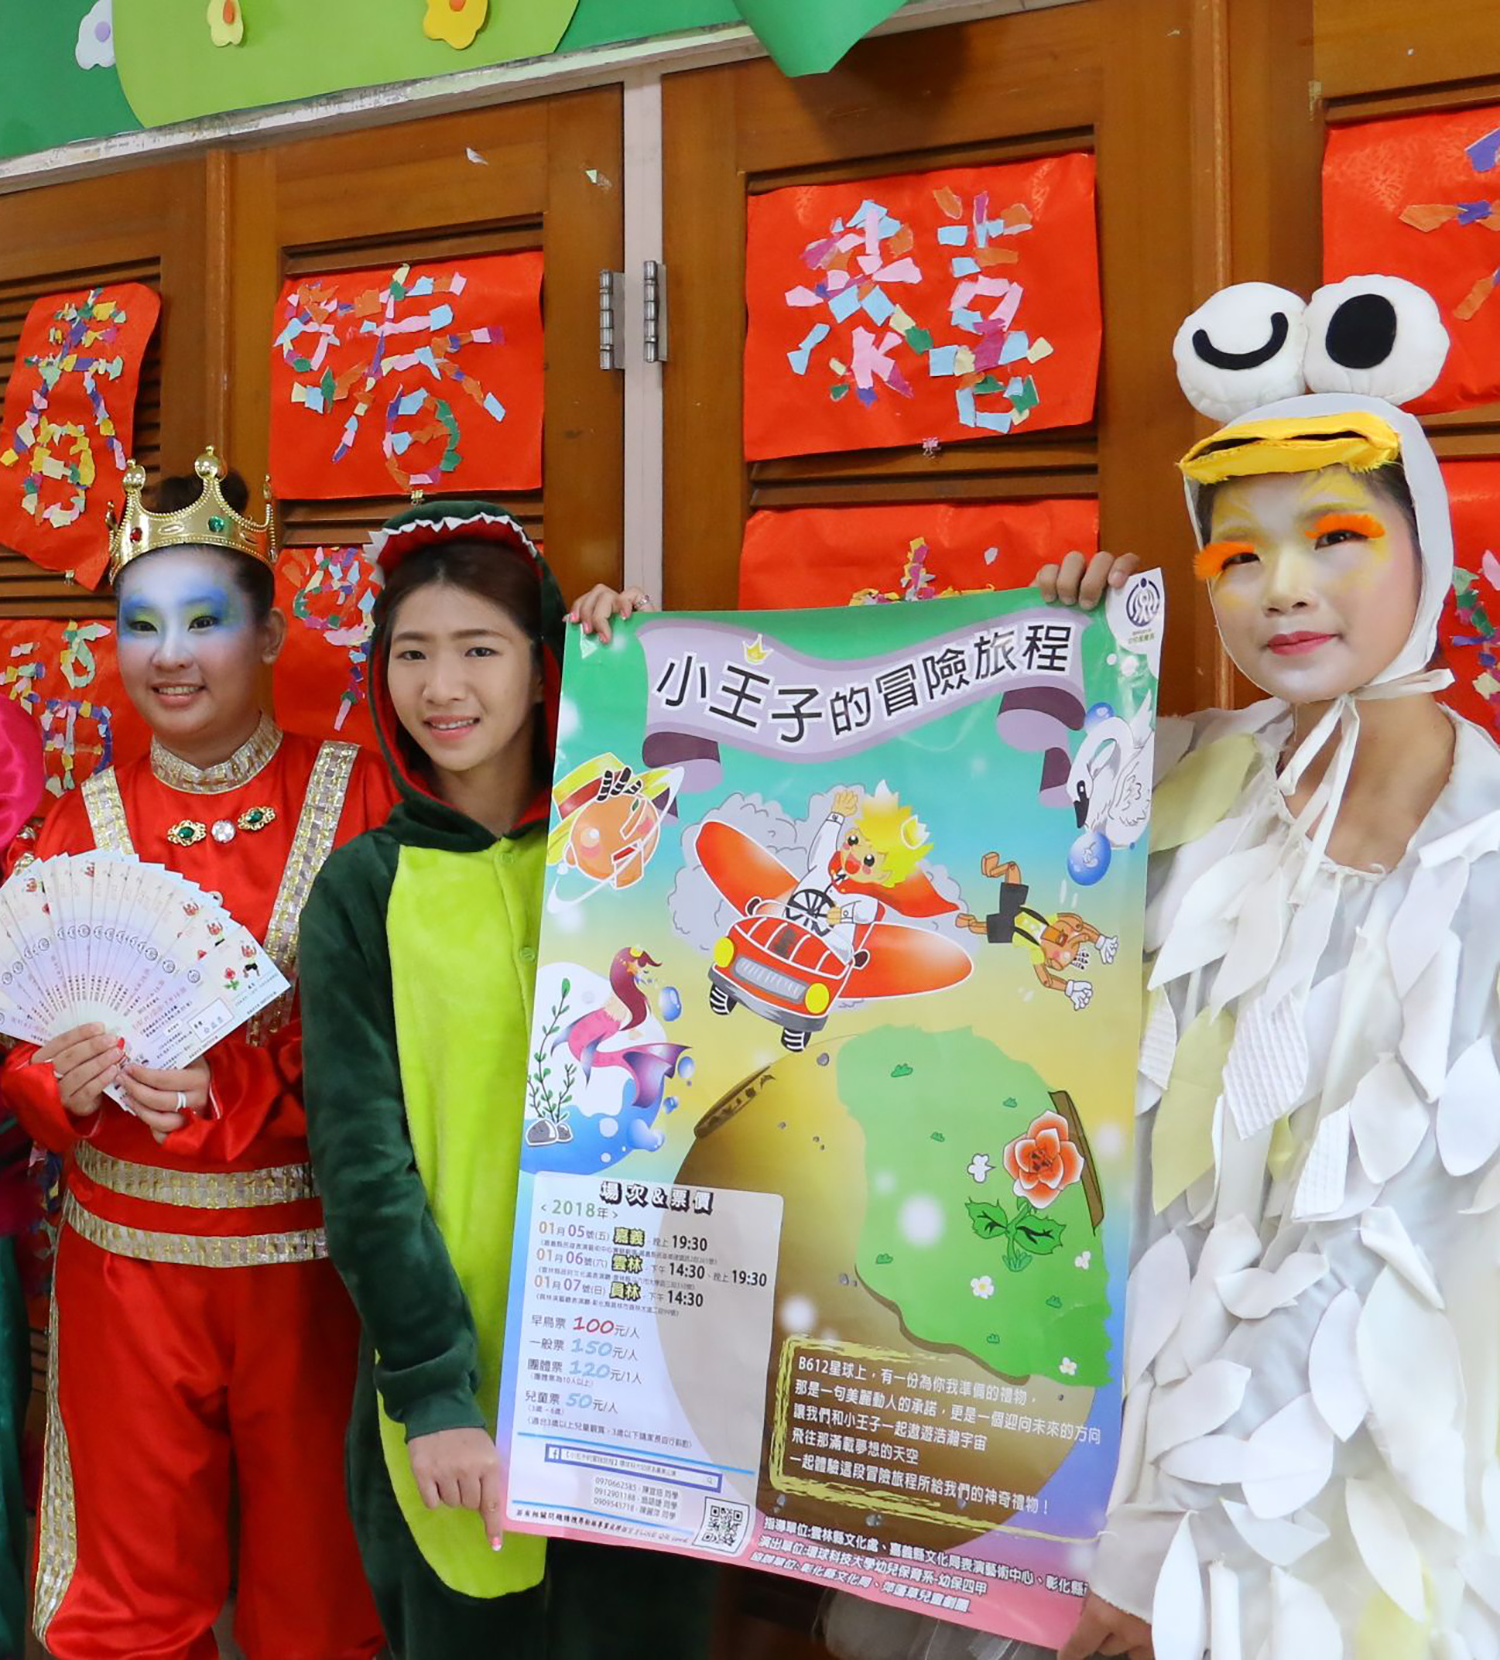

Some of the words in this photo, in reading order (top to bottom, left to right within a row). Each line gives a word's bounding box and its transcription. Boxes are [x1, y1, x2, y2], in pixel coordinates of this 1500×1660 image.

[656, 623, 1072, 745] 小王子的冒險旅程
[599, 1181, 714, 1215] 場次&票價
[672, 1235, 708, 1252] 19:30
[732, 1269, 767, 1287] 19:30
[667, 1290, 703, 1307] 14:30
[793, 1403, 988, 1451] 讓我們和小王子一起遨遊浩瀚宇宙
[791, 1427, 919, 1466] 飛往那滿載夢想的天空
